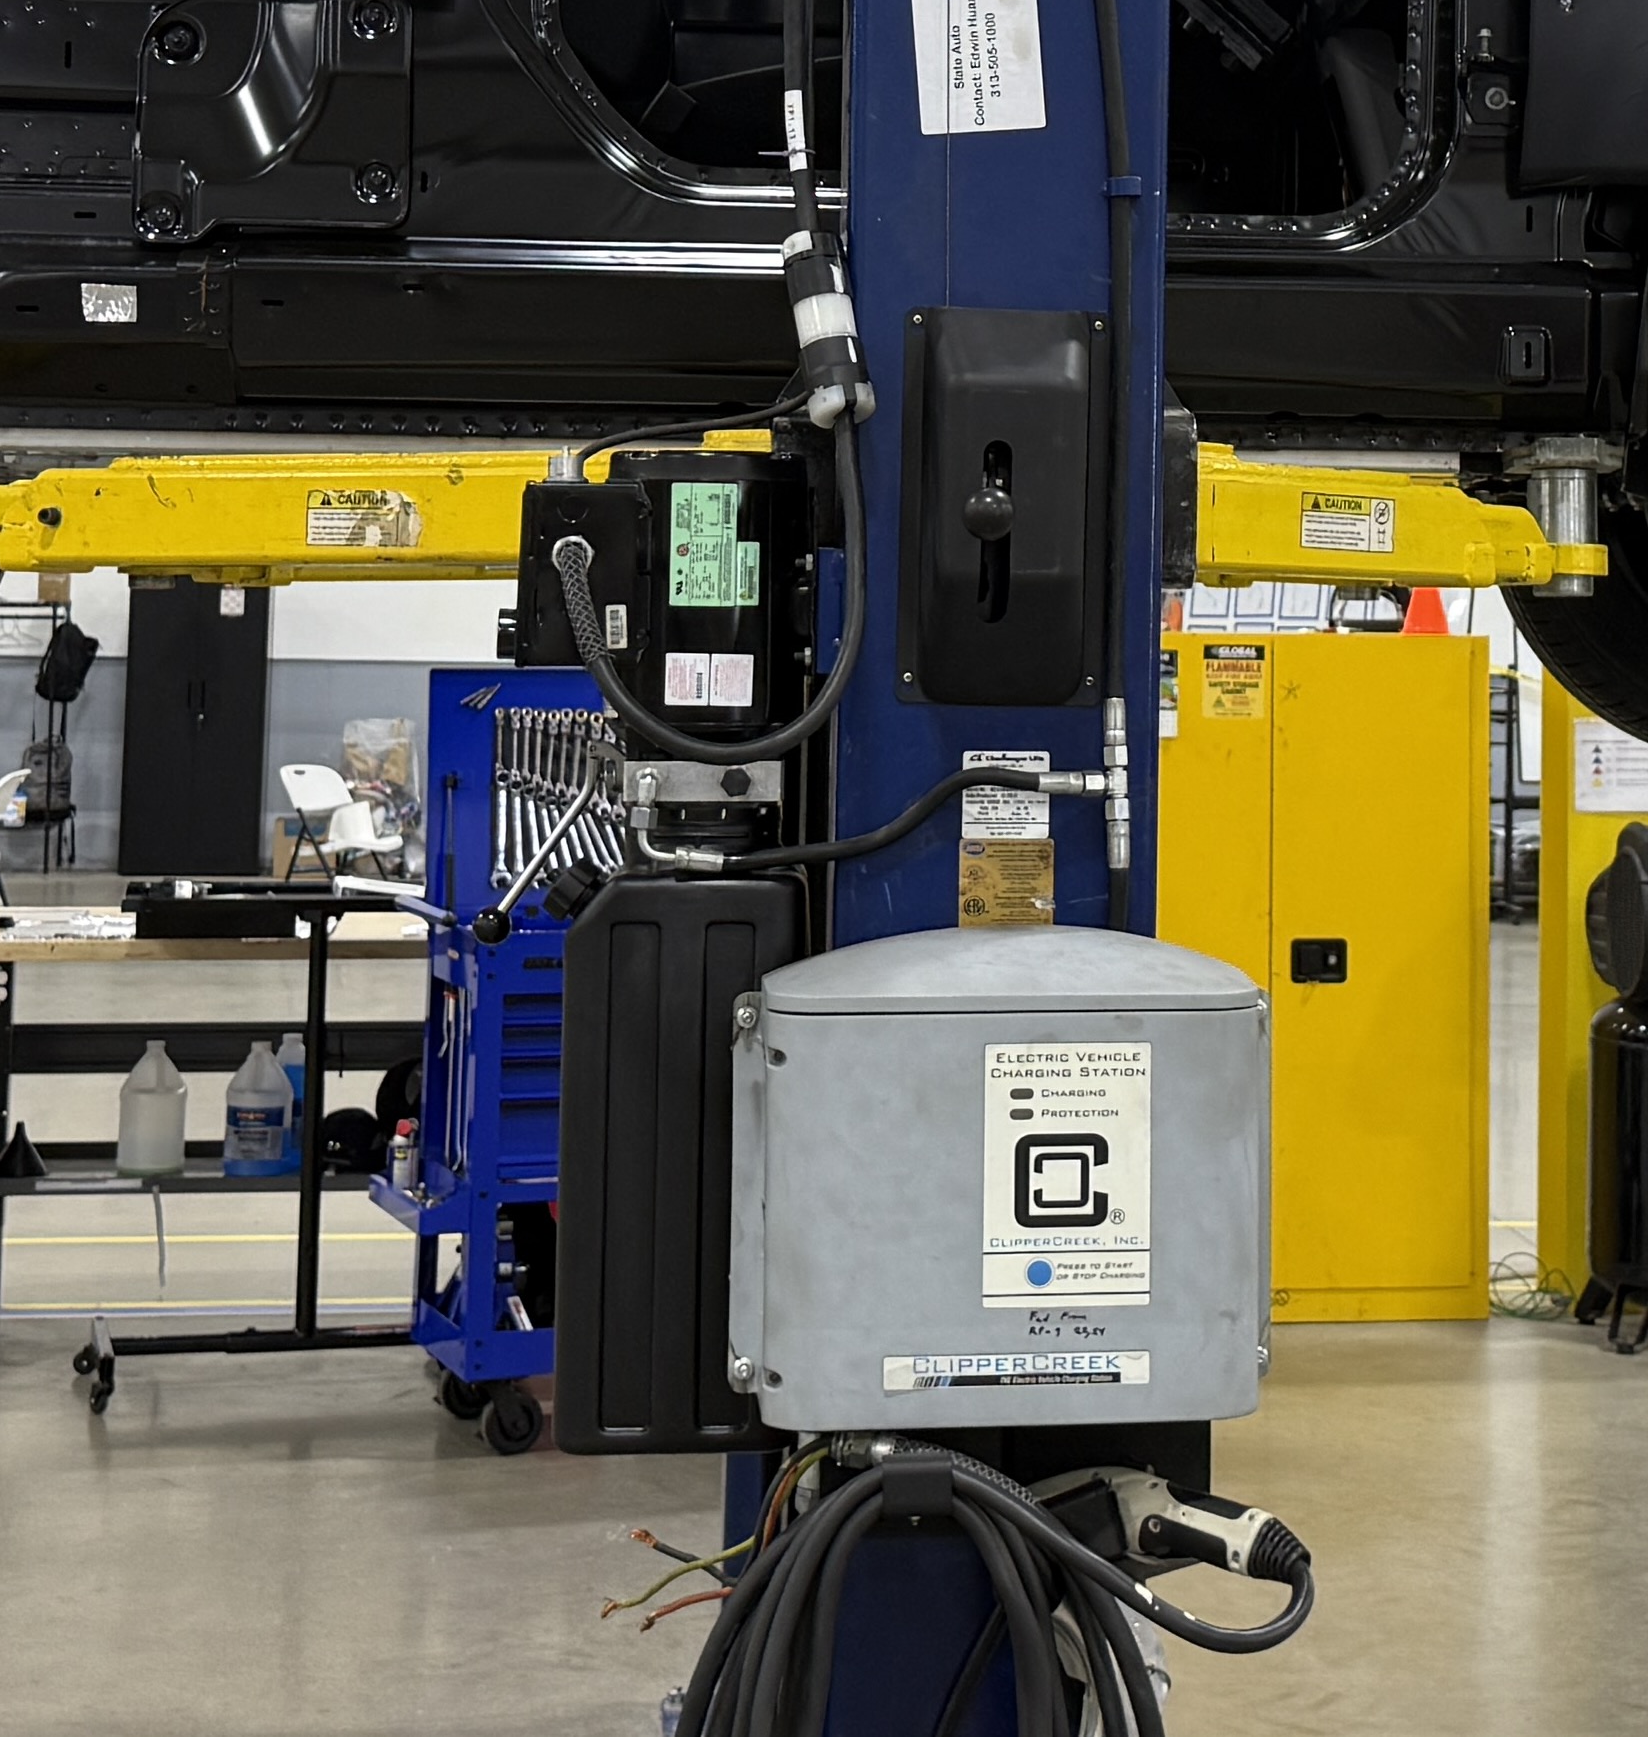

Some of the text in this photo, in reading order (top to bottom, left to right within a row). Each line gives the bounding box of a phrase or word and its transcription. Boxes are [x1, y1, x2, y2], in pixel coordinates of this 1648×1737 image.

[969, 30, 981, 69] Edwin
[337, 494, 388, 506] CAUTION
[1325, 498, 1363, 511] CAUTION
[996, 1052, 1141, 1063] ELECTRIC VEHICLE
[990, 1067, 1146, 1078] CHARGING STATION
[1041, 1089, 1106, 1098] CHARGING
[1041, 1108, 1119, 1118] PROTECTION
[1114, 1236, 1144, 1245] INC.
[912, 1354, 1121, 1374] CLIPPERCREEK
